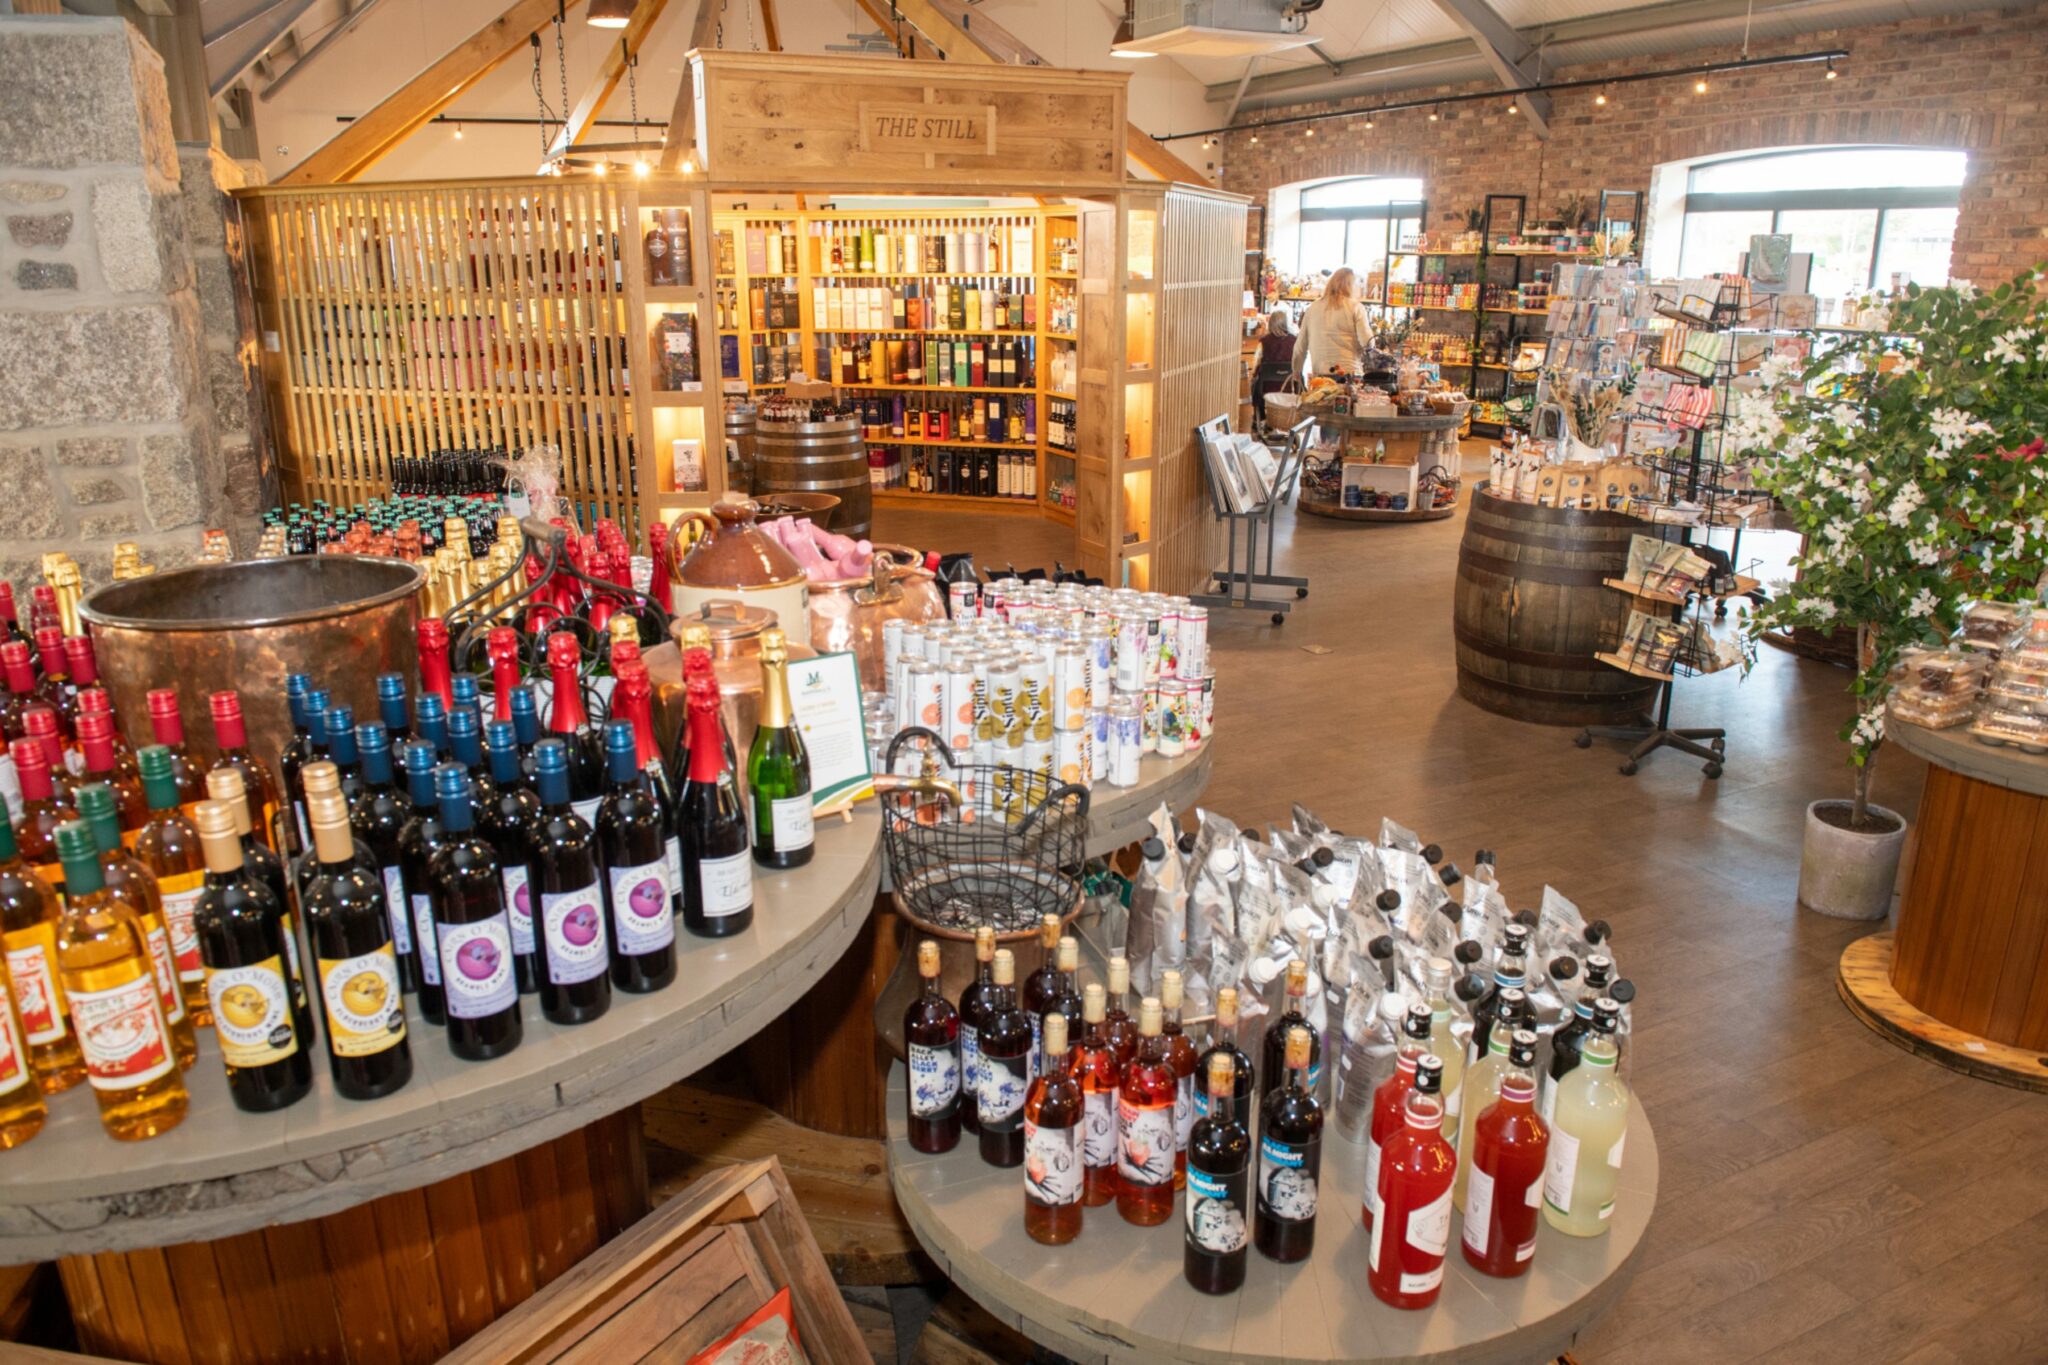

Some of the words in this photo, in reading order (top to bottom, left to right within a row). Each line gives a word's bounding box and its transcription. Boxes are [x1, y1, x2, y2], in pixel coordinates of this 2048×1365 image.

[876, 116, 918, 138] THE
[922, 117, 977, 139] STILL
[974, 679, 989, 721] Sipful
[1001, 688, 1016, 729] Sipful
[1026, 680, 1042, 721] Sipful
